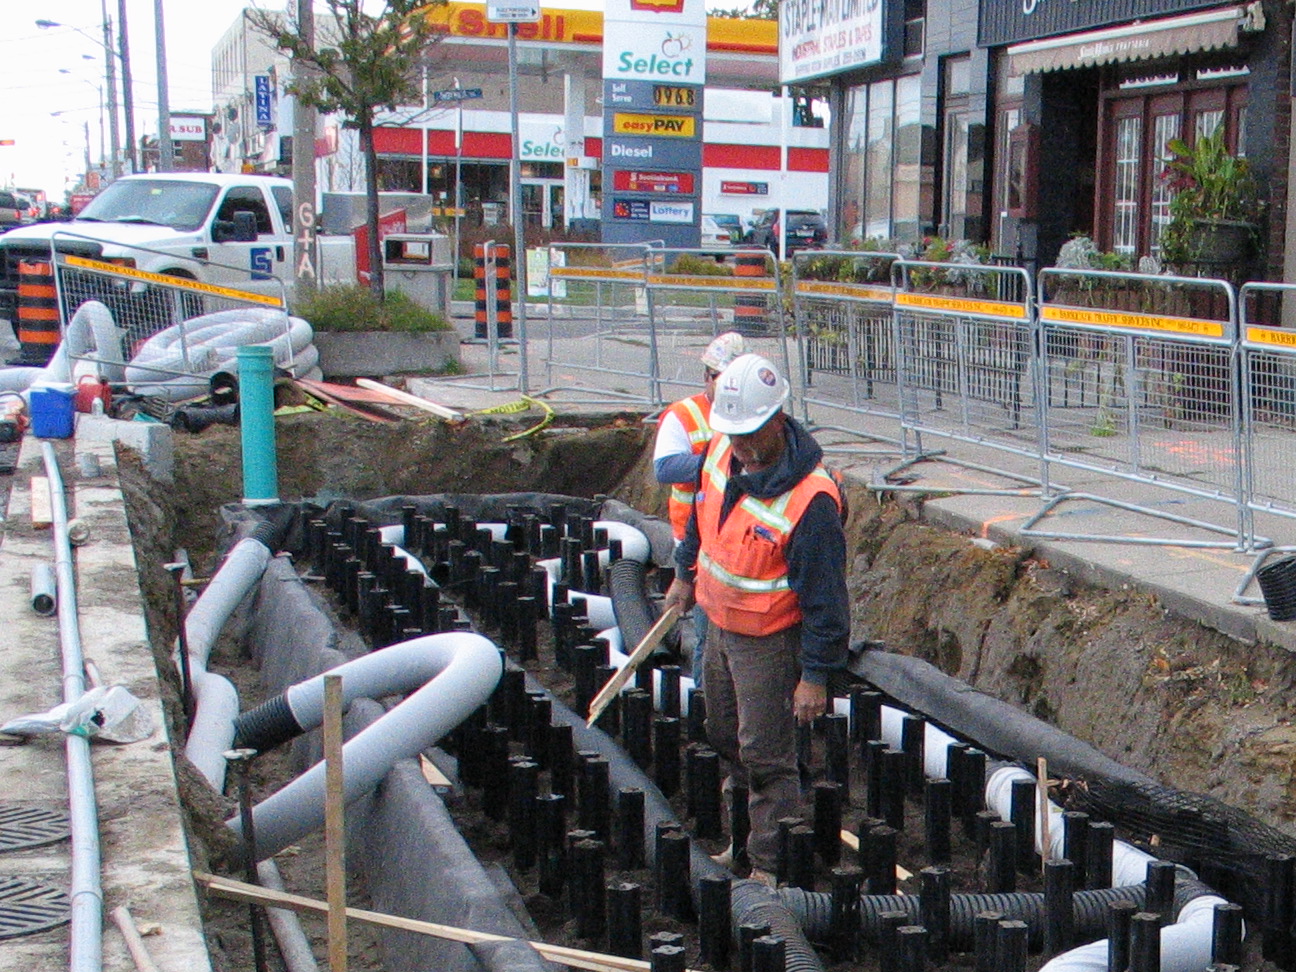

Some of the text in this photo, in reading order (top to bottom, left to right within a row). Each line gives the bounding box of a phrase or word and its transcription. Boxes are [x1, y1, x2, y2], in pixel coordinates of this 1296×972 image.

[618, 51, 693, 76] Select
[623, 119, 685, 133] easyPAY
[521, 140, 565, 158] Sele
[611, 143, 653, 158] Diesel
[652, 204, 690, 217] Lottery
